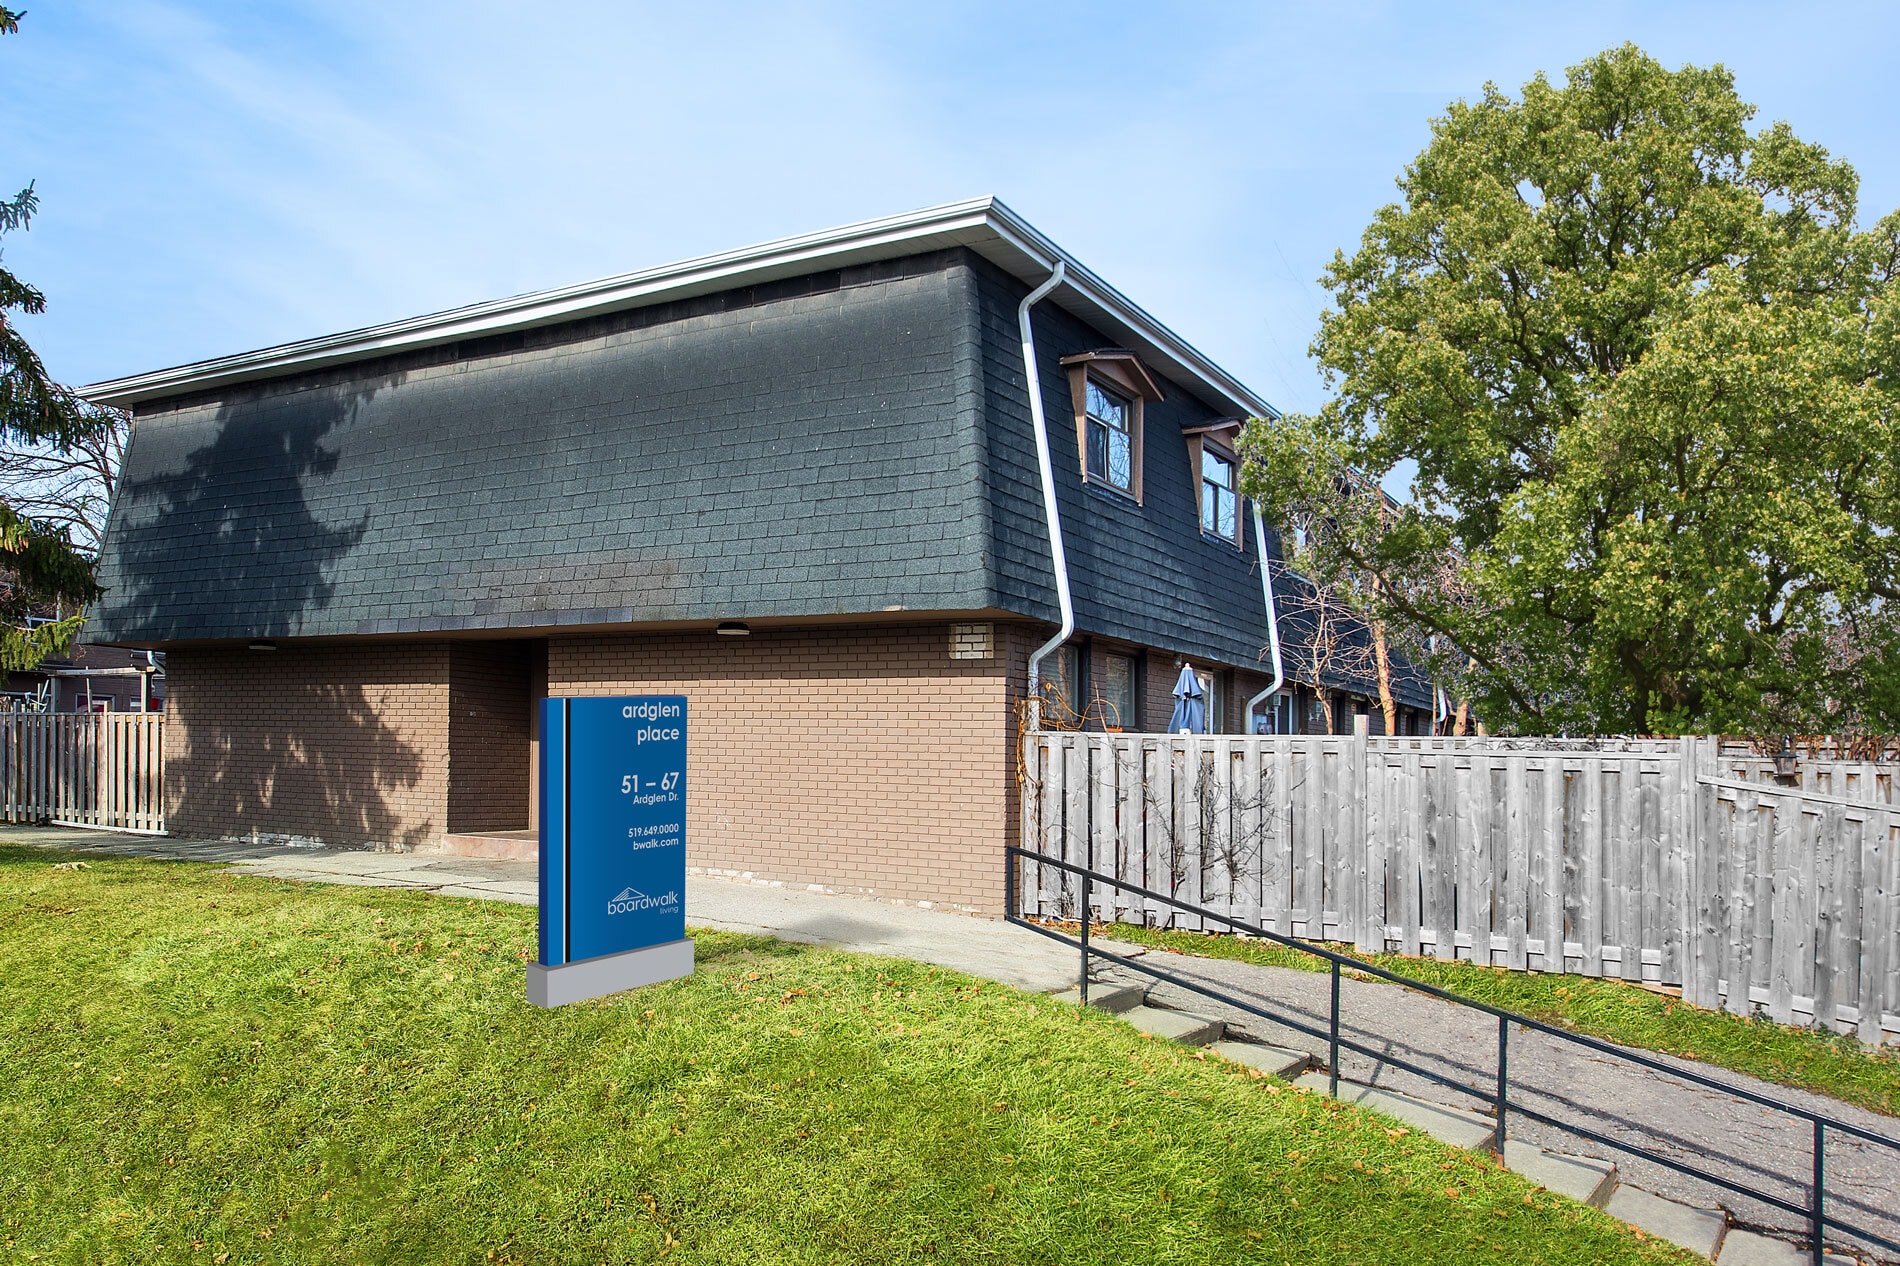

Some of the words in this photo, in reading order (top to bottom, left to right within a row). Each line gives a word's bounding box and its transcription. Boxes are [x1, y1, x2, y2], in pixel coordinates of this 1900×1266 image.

[622, 702, 680, 721] ardglen
[637, 726, 680, 745] place
[621, 774, 639, 794] 51
[661, 772, 680, 791] 67
[633, 794, 666, 806] Ardglen
[668, 792, 679, 802] Dr.
[628, 824, 680, 838] 519.649.0000
[633, 838, 679, 850] bwalk.com
[607, 891, 679, 914] boardwalk
[660, 905, 679, 915] living
